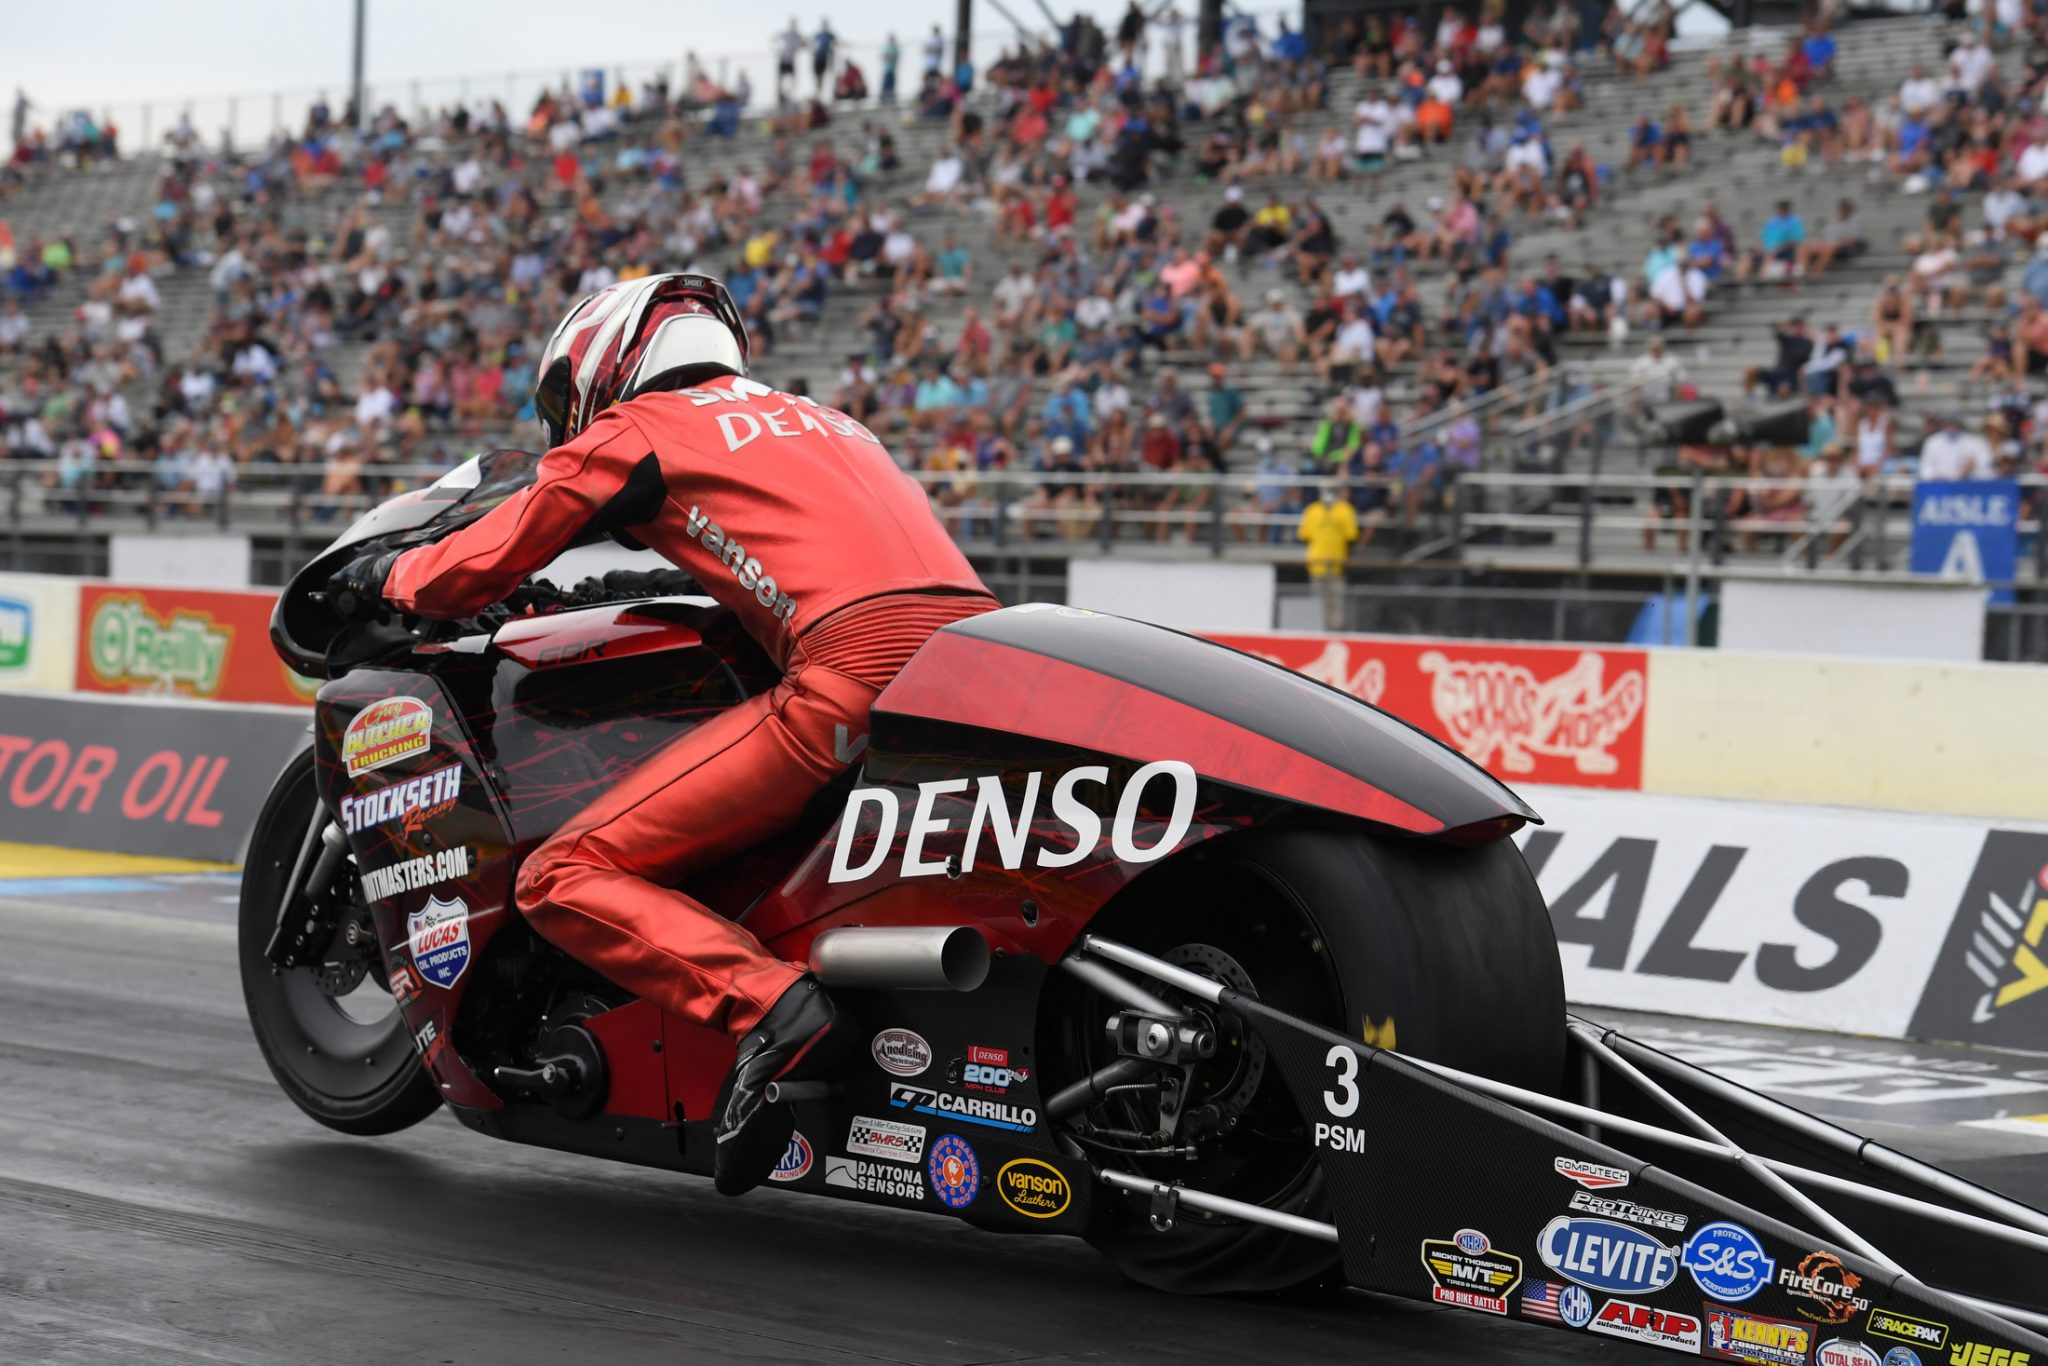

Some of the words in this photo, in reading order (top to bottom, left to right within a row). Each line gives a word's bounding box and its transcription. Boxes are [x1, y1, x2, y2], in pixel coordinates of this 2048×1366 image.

[1918, 494, 2010, 527] AISLE
[685, 506, 798, 624] vanson
[1940, 528, 1985, 584] A
[94, 599, 230, 690] O'Reilly
[346, 711, 429, 754] BUTCHER
[352, 736, 424, 768] TRUCKING
[121, 750, 229, 828] OIL
[341, 763, 462, 835] STOCKSETH
[402, 798, 457, 839] Racing
[828, 760, 1198, 884] DENSO
[417, 922, 460, 955] LUCAS
[419, 958, 430, 971] OIL
[429, 945, 468, 967] PRODUCTS
[978, 1051, 1004, 1062] DENSO
[963, 1063, 1010, 1087] 200
[1323, 1045, 1360, 1118] 3
[964, 1082, 983, 1091] MPH
[985, 1085, 1006, 1095] CLUB
[938, 1093, 1037, 1126] CARRILLO
[869, 1132, 904, 1148] BMRS
[1314, 1122, 1366, 1154] PSM
[775, 1142, 802, 1170] RA
[774, 1169, 799, 1179] RACING
[857, 1161, 923, 1185] DAYTONA
[1556, 1159, 1628, 1180] COMPUTECH
[857, 1176, 925, 1200] SENSORS
[1007, 1171, 1063, 1196] vanson
[1013, 1189, 1057, 1209] Leathers
[1581, 1205, 1673, 1229] APPAREL
[1461, 1236, 1485, 1251] NHRA
[1713, 1229, 1743, 1242] PROVEN
[1432, 1251, 1464, 1263] MICKEY
[1464, 1257, 1512, 1272] THOMPSON
[1542, 1218, 1672, 1286] CLEVITE
[1693, 1243, 1759, 1279] S&S
[1446, 1278, 1465, 1287] TIRES
[1471, 1282, 1495, 1293] WHEELS
[1452, 1263, 1495, 1283] M/T
[1701, 1277, 1752, 1295] PERFORMANCE
[1779, 1268, 1854, 1299] FireCore
[1851, 1297, 1869, 1311] 50
[1440, 1288, 1455, 1300] PRO
[1456, 1290, 1473, 1305] BIKE
[1474, 1295, 1501, 1310] BATTLE
[1562, 1286, 1590, 1321] CHA
[1599, 1302, 1697, 1336] ARP
[1884, 1318, 1941, 1343] RACEPAK
[1596, 1321, 1640, 1334] automotive
[1661, 1334, 1696, 1346] products
[1732, 1317, 1809, 1354] KENNY'S
[1824, 1351, 1849, 1366] TOTAL
[1950, 1342, 2031, 1366] JEGS
